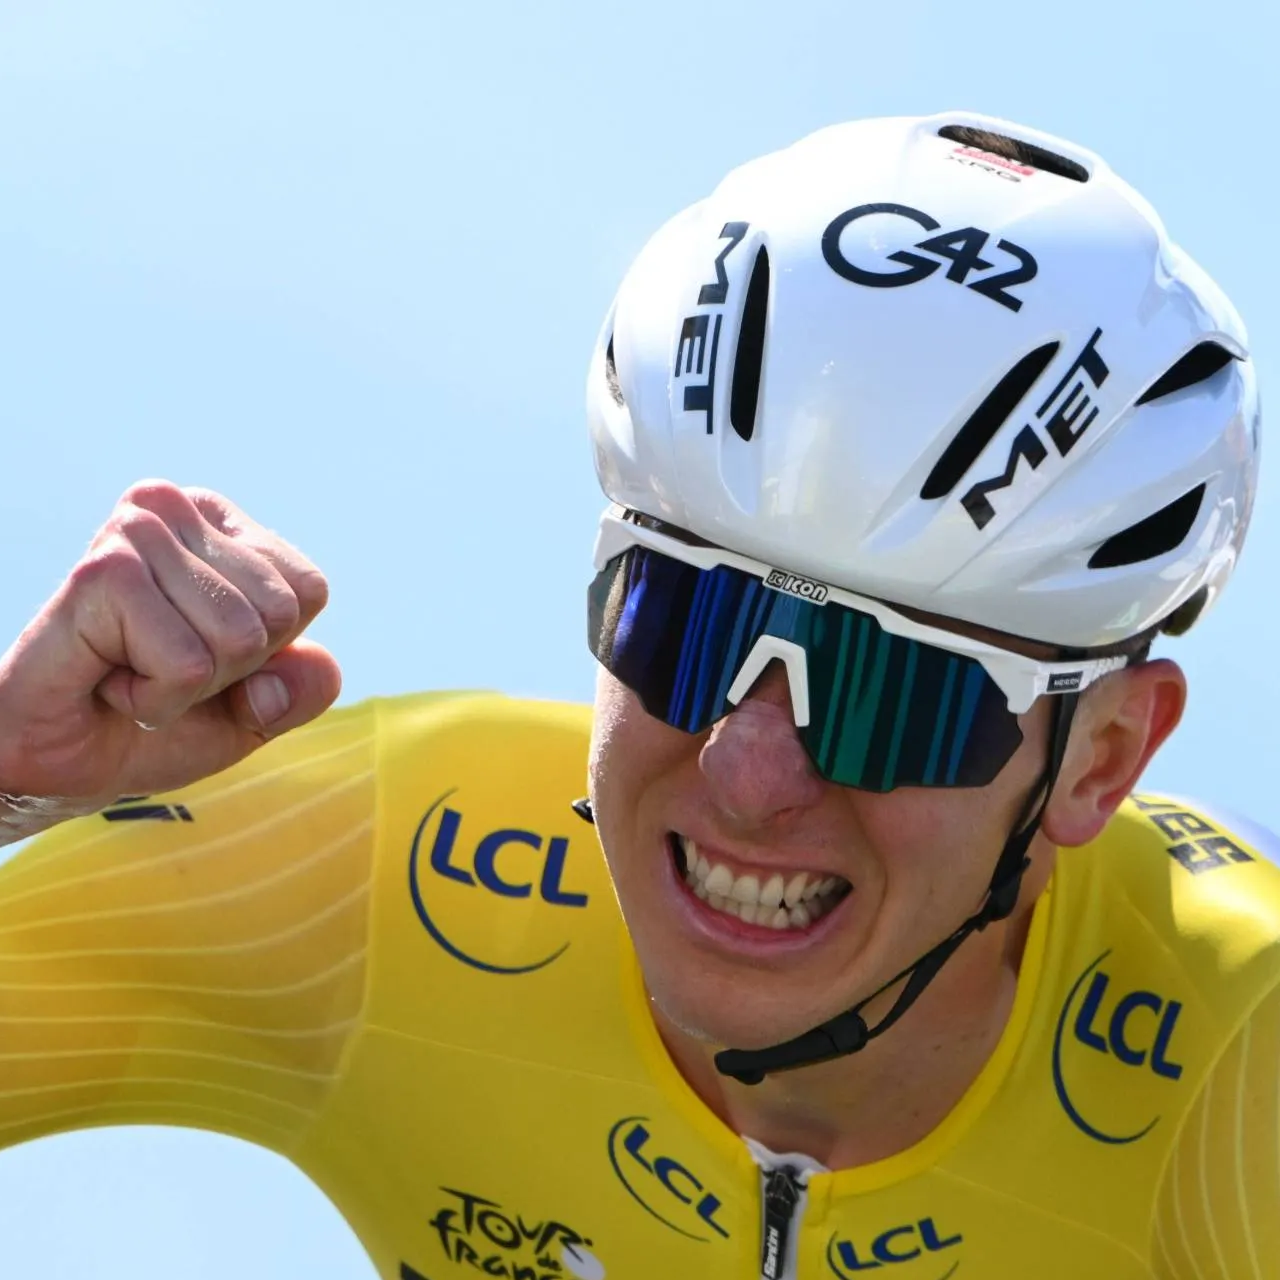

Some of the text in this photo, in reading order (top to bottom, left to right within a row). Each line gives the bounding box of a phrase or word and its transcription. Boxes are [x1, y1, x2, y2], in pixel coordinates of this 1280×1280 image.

[821, 203, 1038, 313] G42
[674, 221, 751, 435] MET
[959, 327, 1110, 531] MET
[430, 808, 589, 908] LCL
[1073, 970, 1184, 1082] LCL
[623, 1123, 730, 1239] LCL
[836, 1216, 963, 1271] LCL
